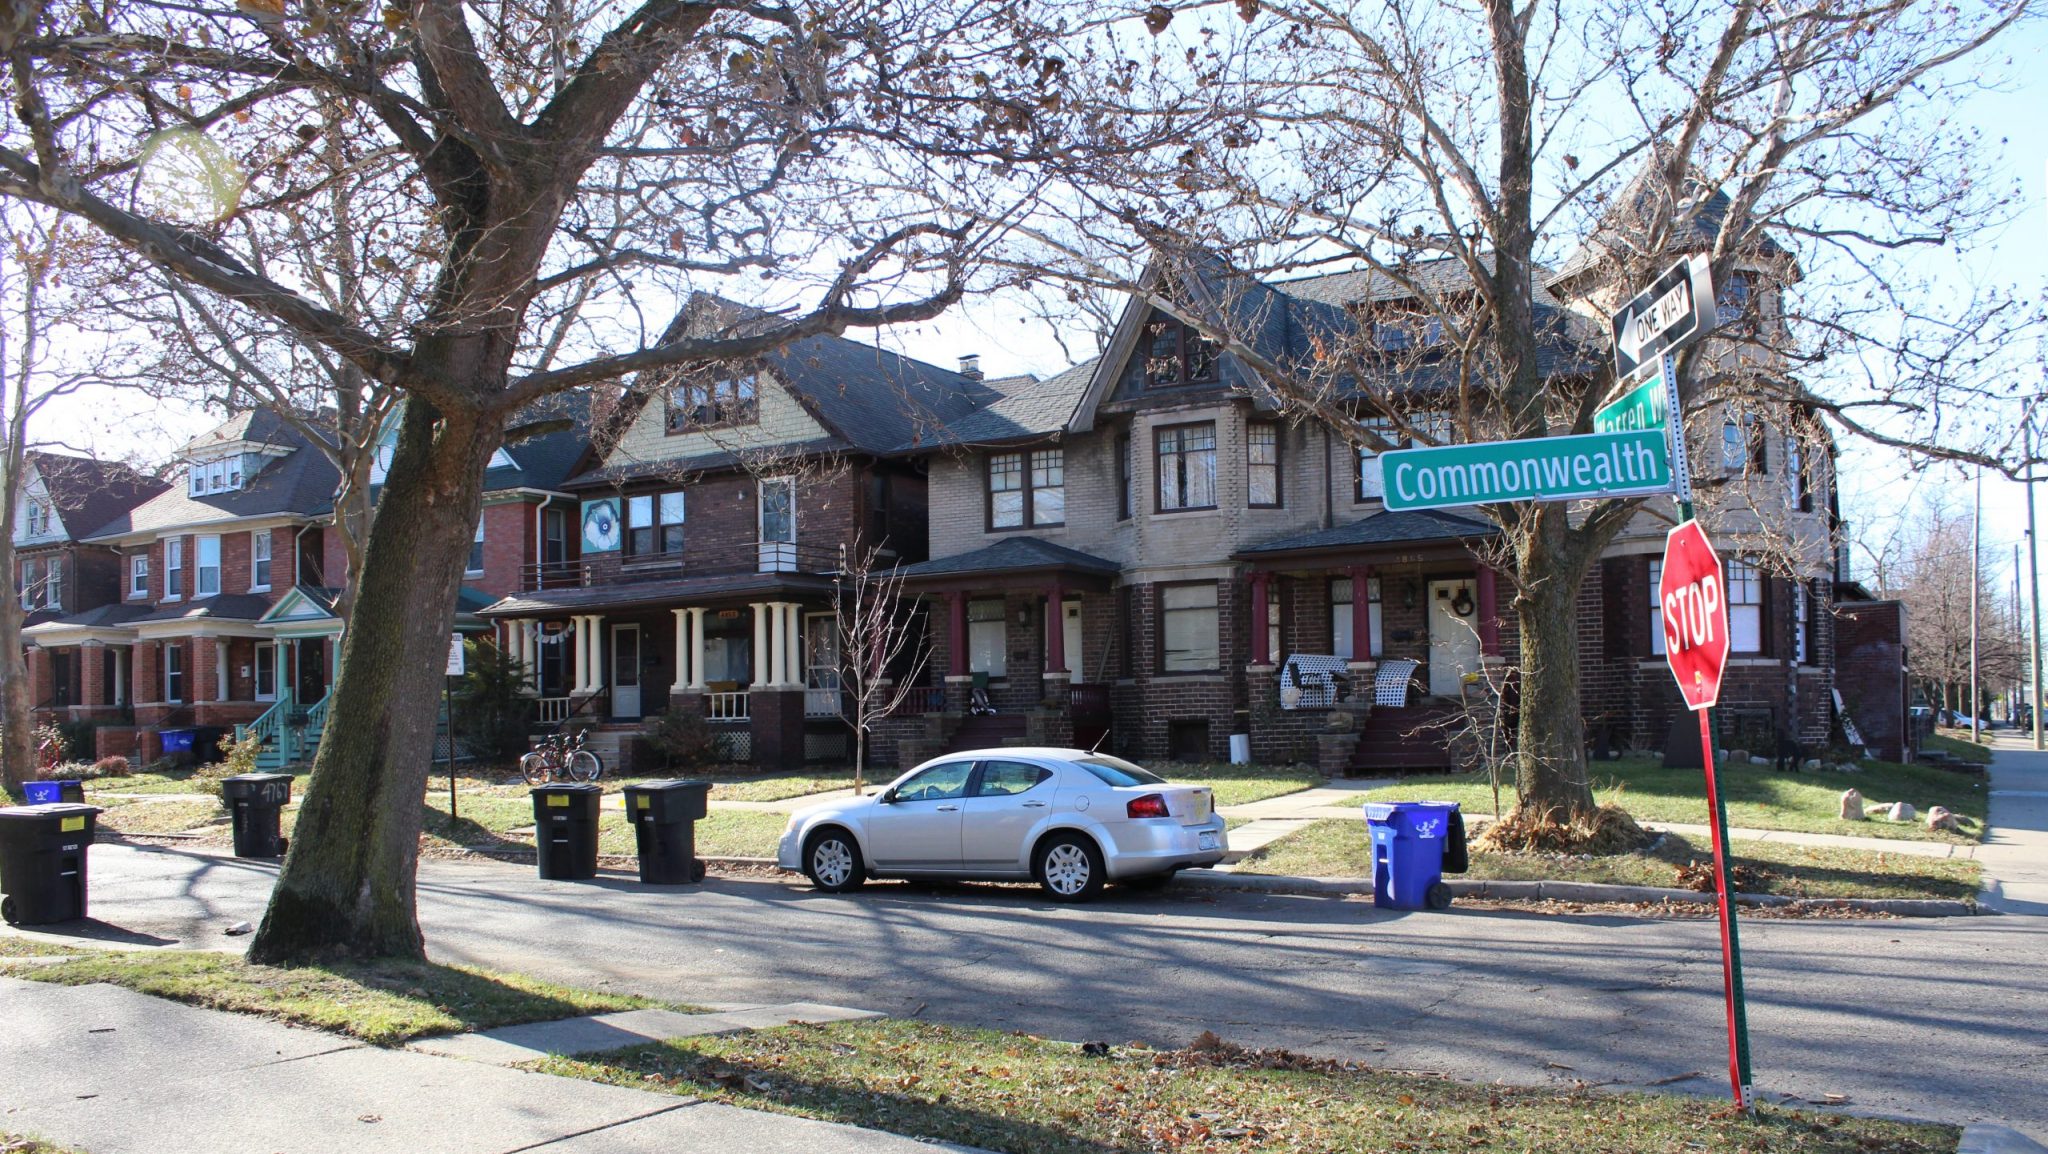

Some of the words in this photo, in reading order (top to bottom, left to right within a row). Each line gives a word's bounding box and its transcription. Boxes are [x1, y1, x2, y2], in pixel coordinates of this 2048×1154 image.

[1637, 308, 1660, 342] ONE
[1661, 284, 1684, 325] WAY
[1395, 440, 1657, 501] Commonwealth
[1665, 575, 1718, 655] STOP
